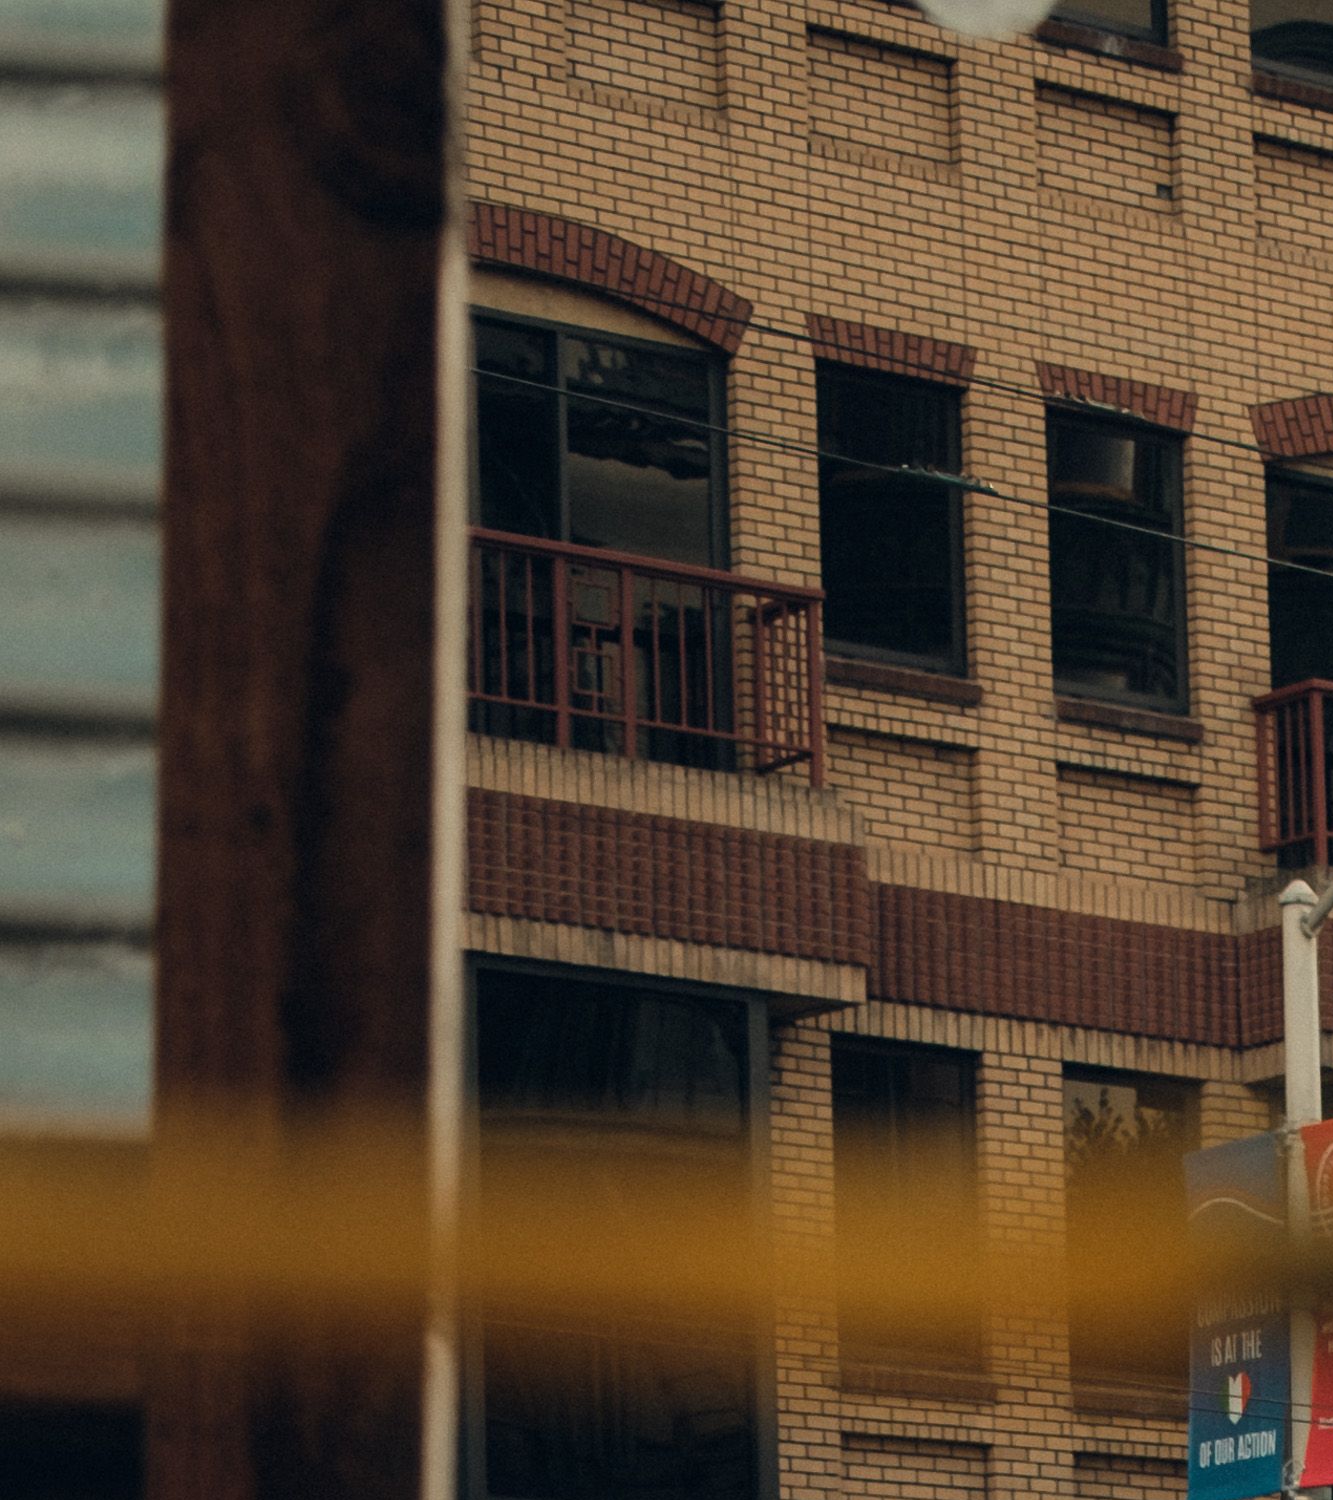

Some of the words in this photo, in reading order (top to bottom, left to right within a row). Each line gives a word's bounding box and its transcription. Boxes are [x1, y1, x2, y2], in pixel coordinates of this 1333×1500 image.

[1211, 1335, 1222, 1368] IS
[1224, 1332, 1238, 1365] AT
[1242, 1329, 1263, 1360] THE
[1199, 1439, 1213, 1469] OF
[1214, 1436, 1235, 1465] OUR
[1237, 1429, 1277, 1461] ACTION
